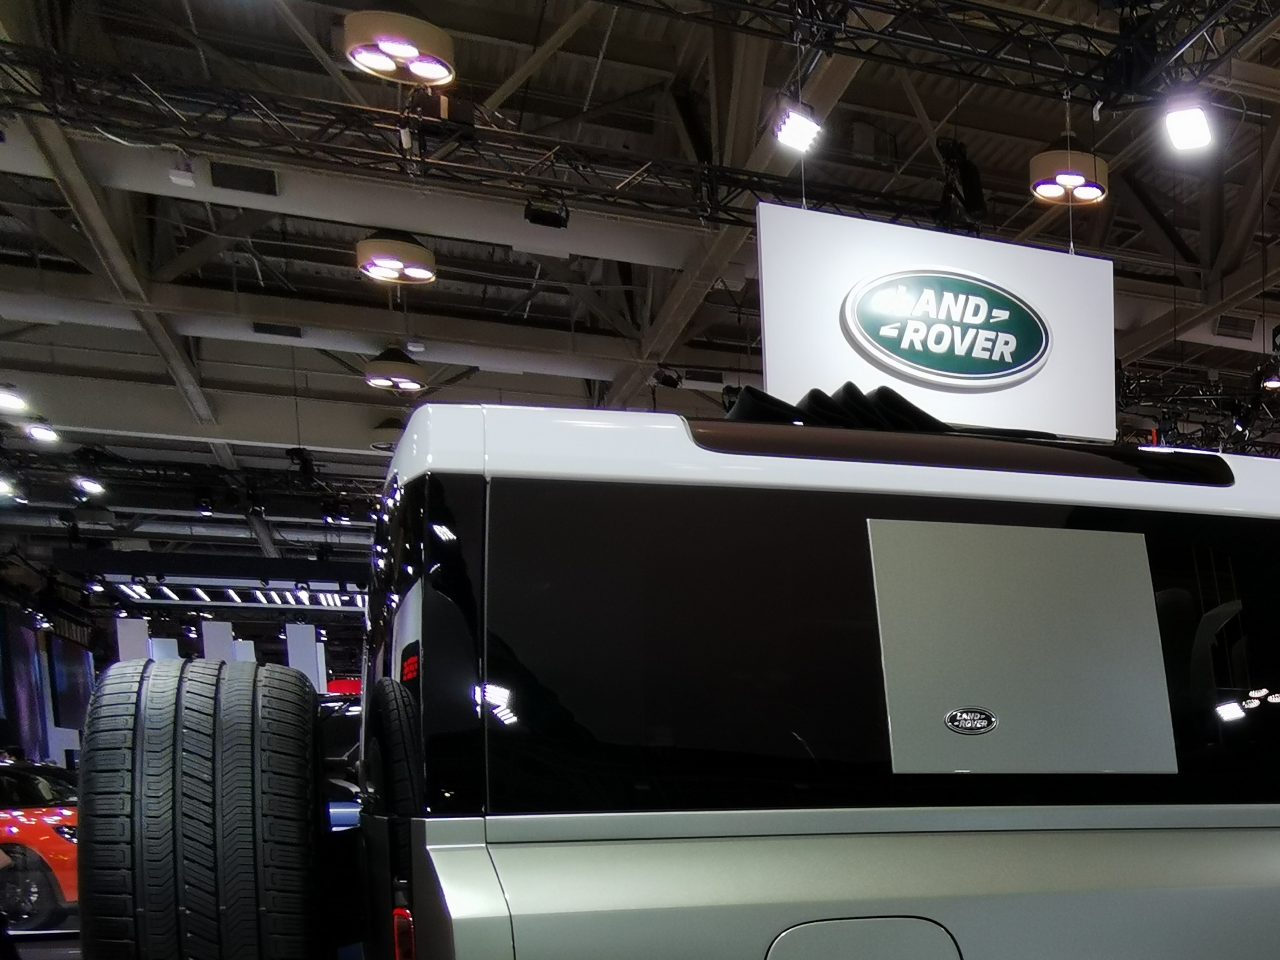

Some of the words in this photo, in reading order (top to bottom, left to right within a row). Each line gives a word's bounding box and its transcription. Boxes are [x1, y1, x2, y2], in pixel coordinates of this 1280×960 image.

[891, 286, 988, 325] AND
[900, 319, 1017, 363] ROVER
[956, 711, 981, 720] LAND
[959, 719, 988, 728] ROVER
